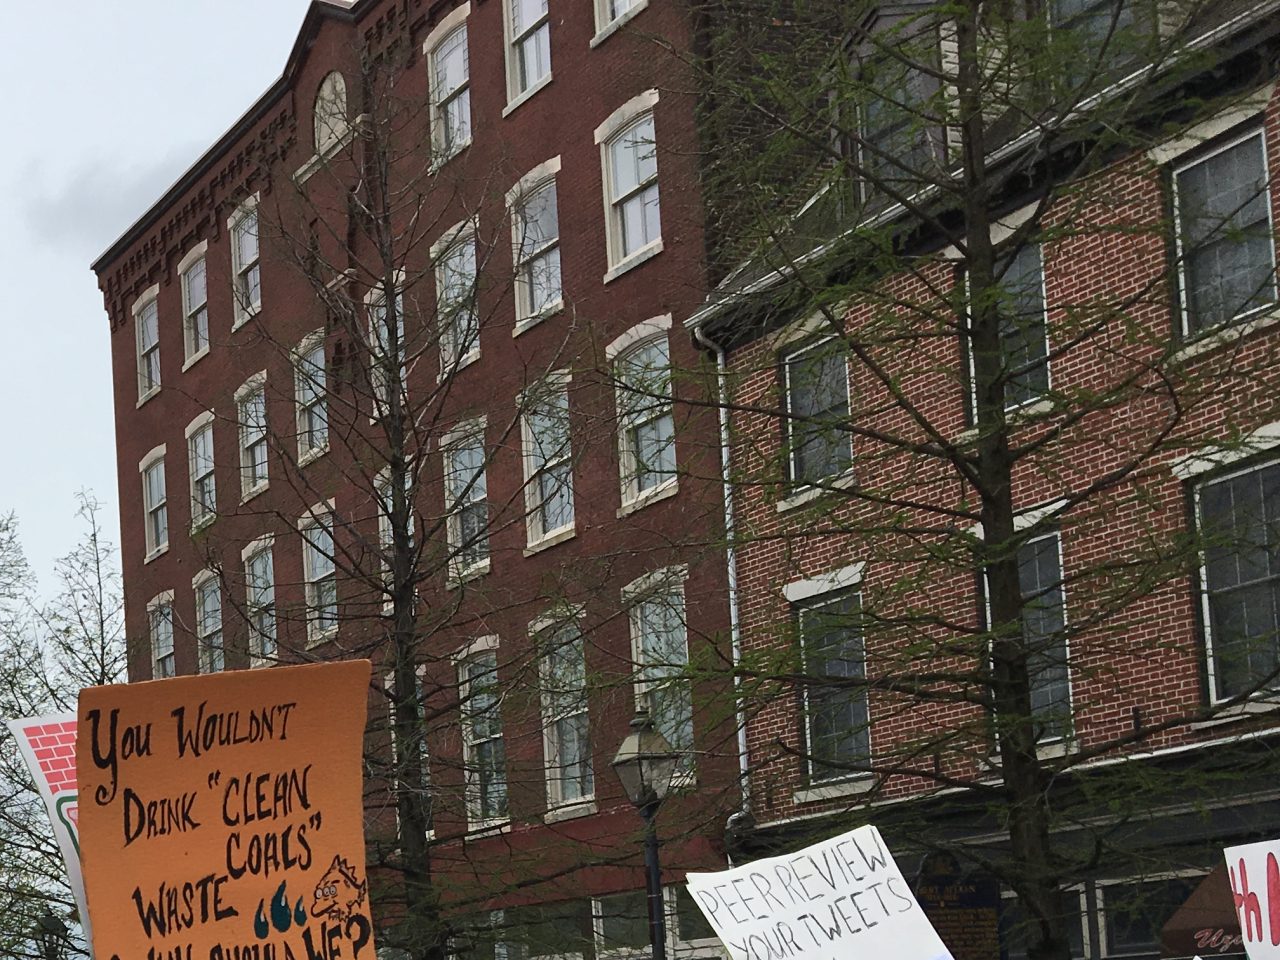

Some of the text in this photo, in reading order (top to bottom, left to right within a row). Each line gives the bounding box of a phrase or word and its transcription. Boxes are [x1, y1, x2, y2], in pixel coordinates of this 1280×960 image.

[132, 873, 239, 939] WASTE
[696, 828, 887, 929] PEER REVIEW
[797, 877, 913, 949] TWEETS
